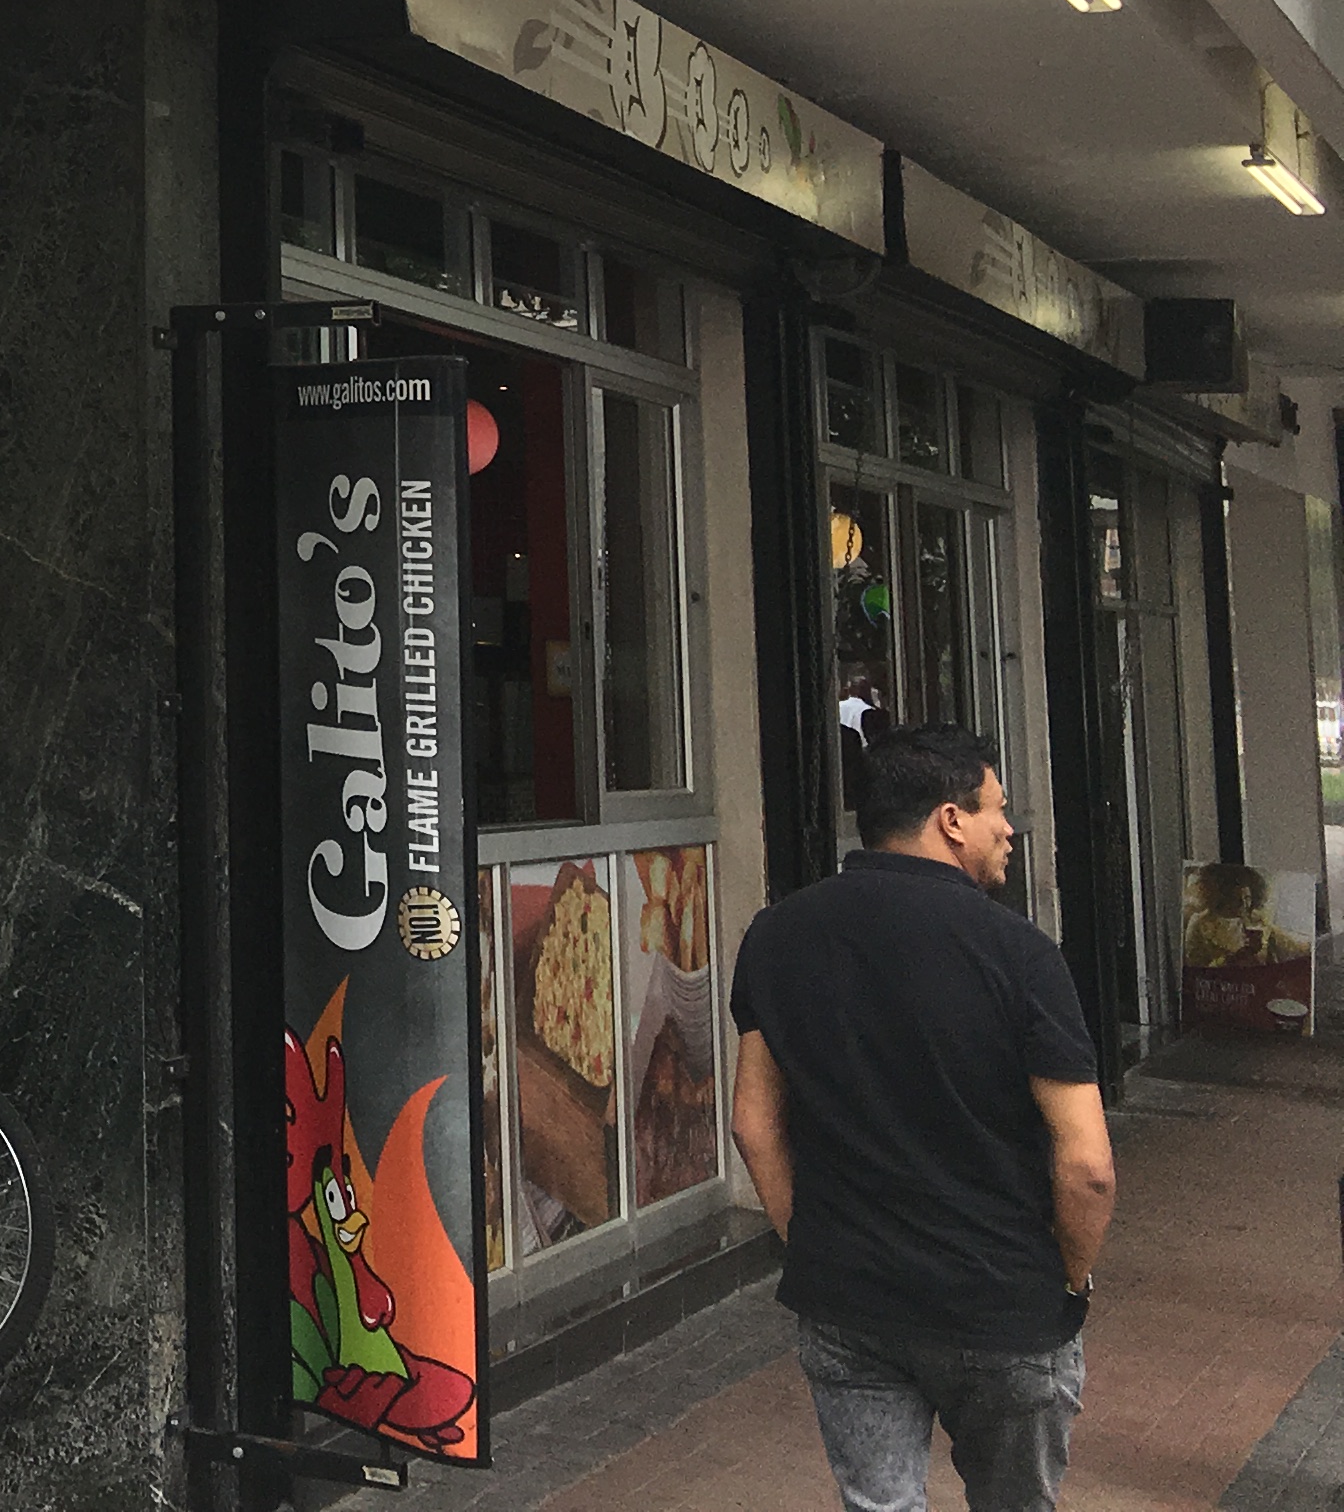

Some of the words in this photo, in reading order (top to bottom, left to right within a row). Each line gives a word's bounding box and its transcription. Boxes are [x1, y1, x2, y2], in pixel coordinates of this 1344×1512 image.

[297, 375, 431, 410] www.galitos.com
[400, 478, 434, 616] CHICKEN
[296, 474, 390, 951] Galito's
[403, 626, 438, 759] GRILLED
[408, 769, 440, 874] FLAME
[407, 904, 444, 944] NO.1
